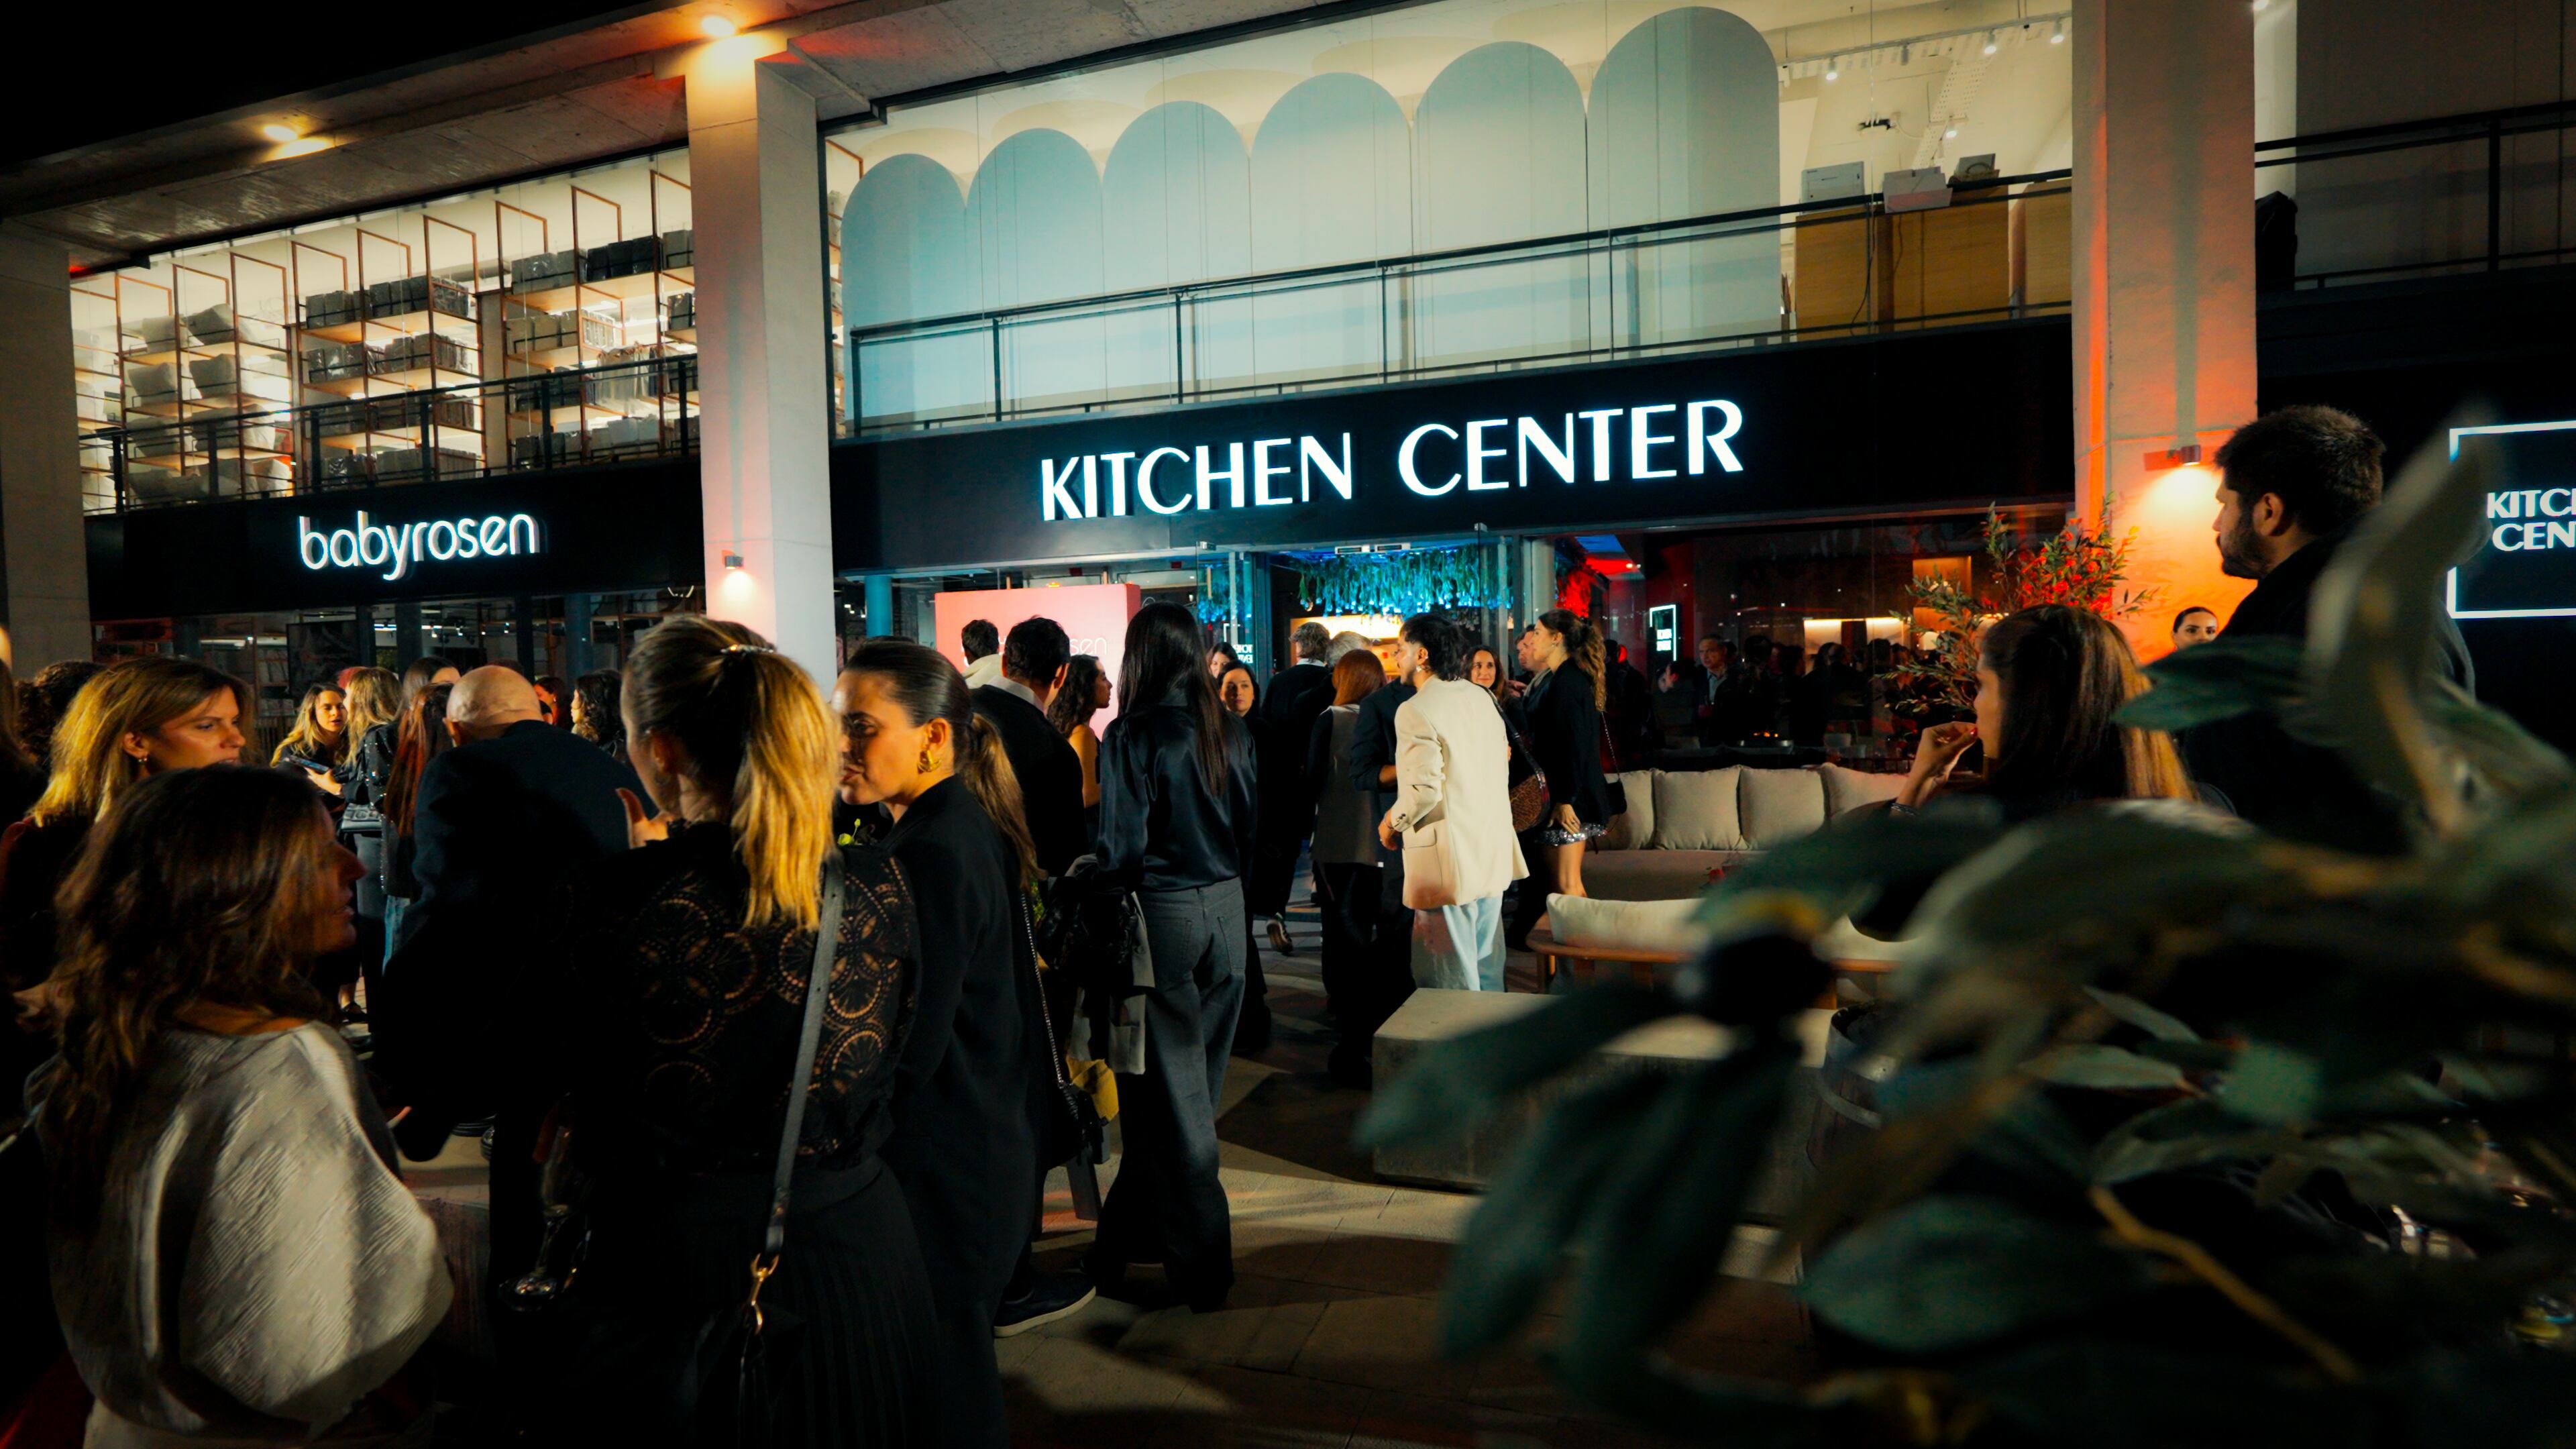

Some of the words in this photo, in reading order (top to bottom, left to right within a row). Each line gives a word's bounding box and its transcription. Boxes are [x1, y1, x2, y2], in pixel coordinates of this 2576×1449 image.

[1041, 432, 1352, 522] KITCHEN
[1397, 398, 1744, 497] CENTER
[2487, 488, 2576, 519] KITC
[299, 510, 538, 582] babyrosen
[2492, 521, 2576, 551] CEN
